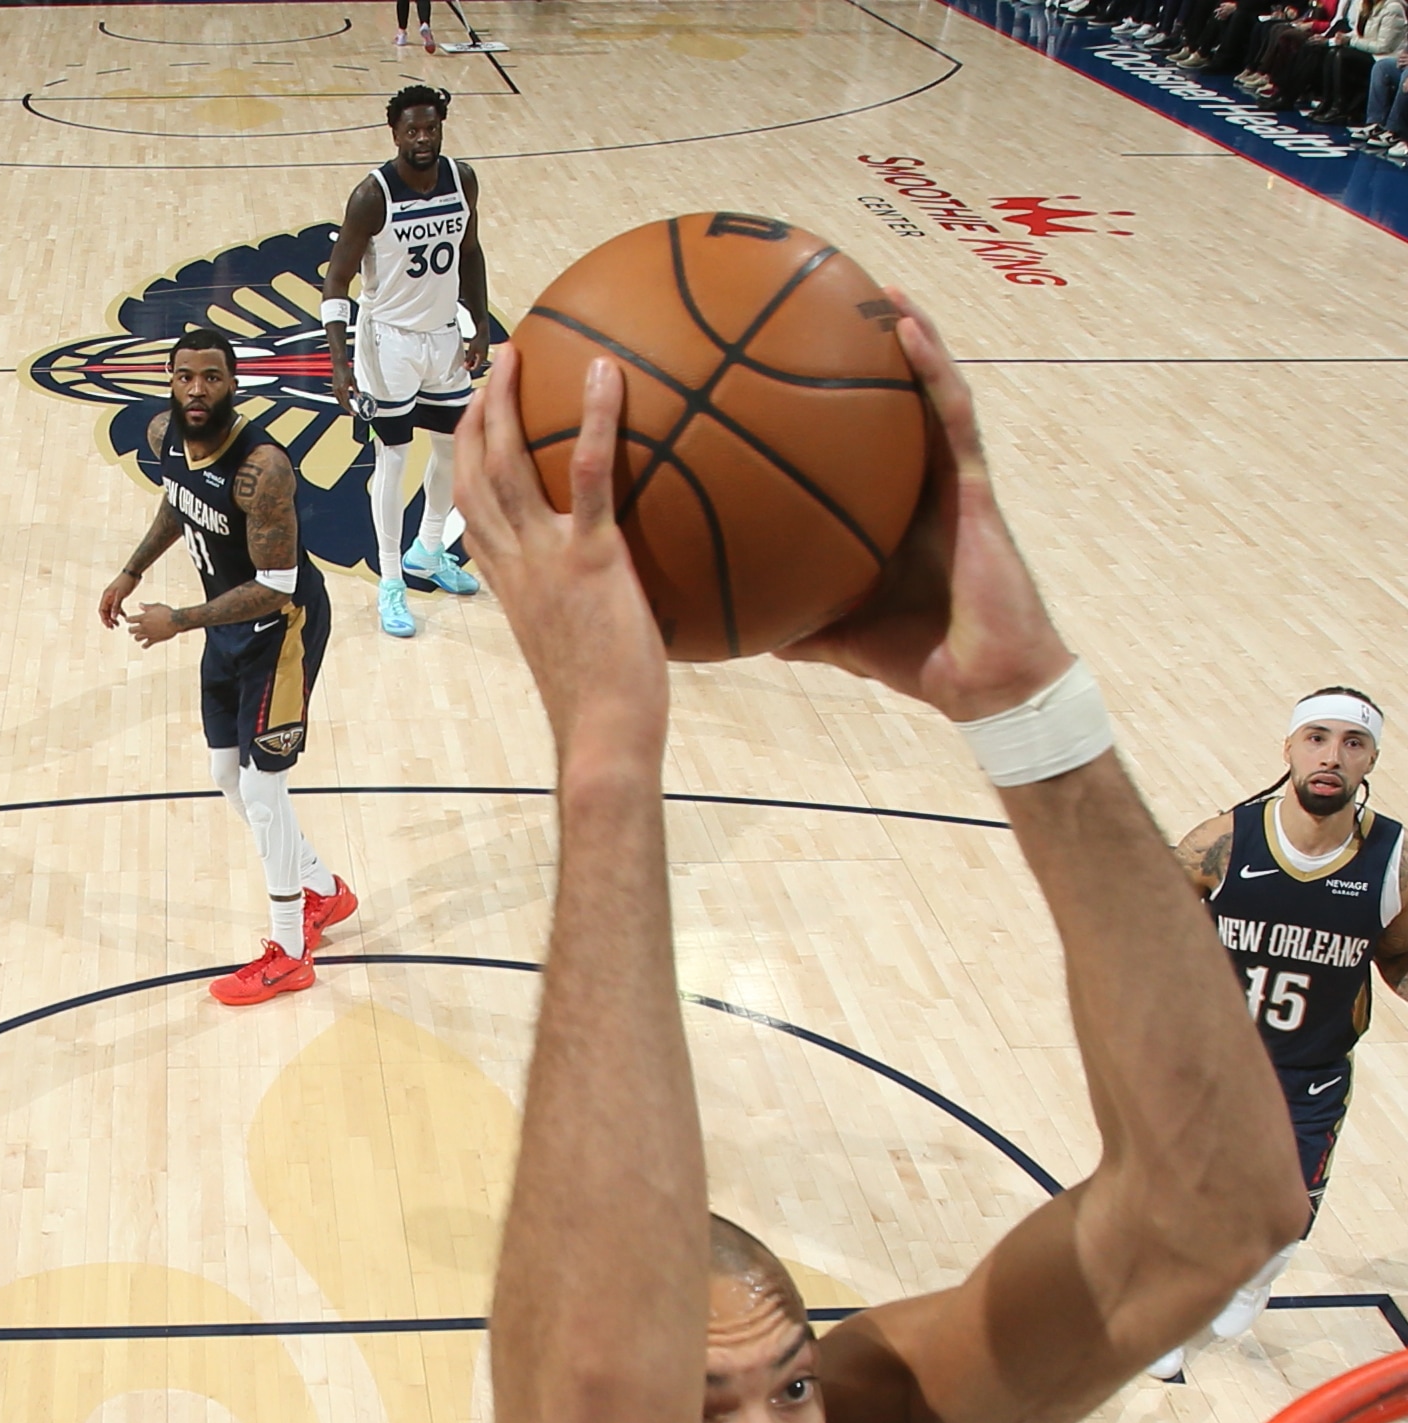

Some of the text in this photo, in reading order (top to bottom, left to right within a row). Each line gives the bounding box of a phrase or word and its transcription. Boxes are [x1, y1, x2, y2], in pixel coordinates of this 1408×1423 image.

[1093, 50, 1356, 158] Ochsner Health
[857, 154, 1001, 234] SMOOTHIE
[857, 196, 926, 237] CENTER
[393, 217, 464, 243] WOLVES
[405, 241, 455, 279] 30
[178, 485, 231, 536] ORLEANS
[1325, 879, 1369, 892] NEWAGE
[1218, 914, 1370, 968] NEW ORLEANS
[1245, 965, 1311, 1032] 15
